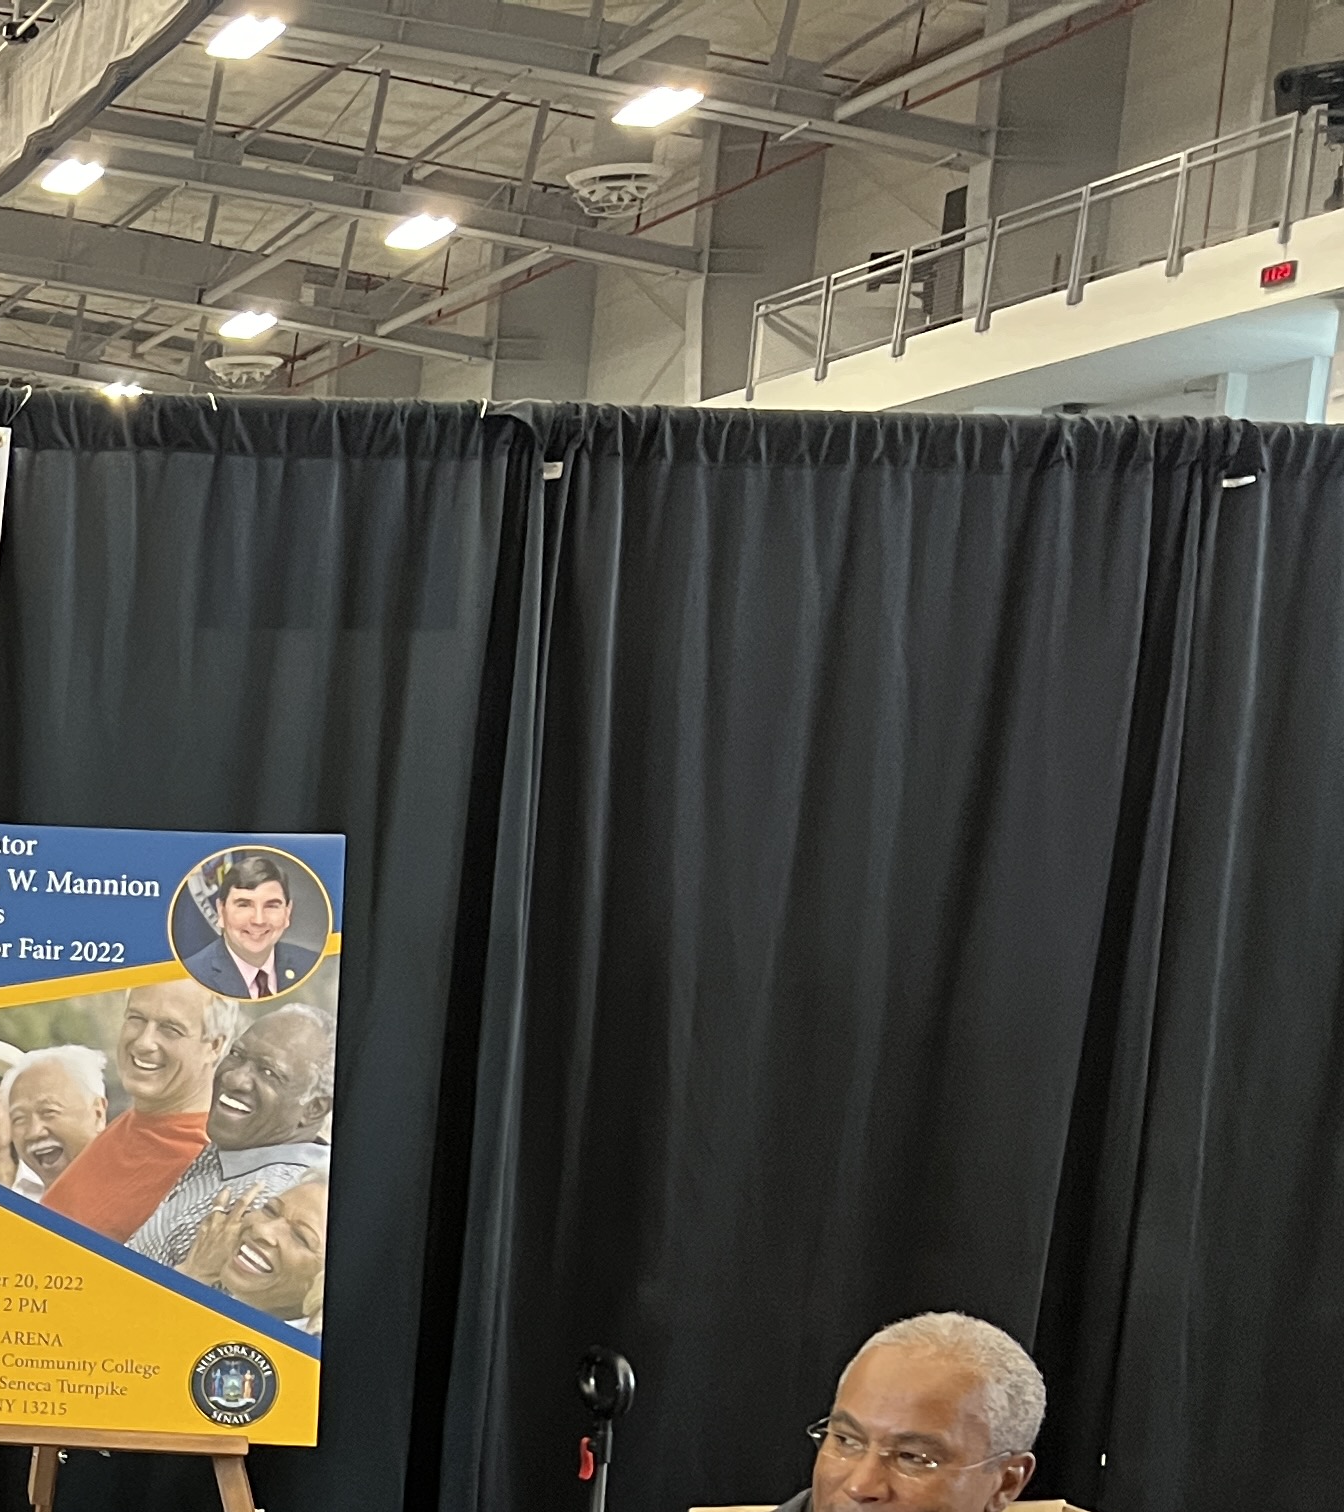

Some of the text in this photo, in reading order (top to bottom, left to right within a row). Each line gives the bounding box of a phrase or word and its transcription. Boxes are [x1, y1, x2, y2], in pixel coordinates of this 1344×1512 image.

[7, 868, 38, 892] W.
[46, 870, 160, 897] Mannion
[19, 937, 64, 961] Fair
[70, 941, 125, 963] 2022
[14, 1274, 38, 1290] 20,
[44, 1275, 84, 1291] 2022
[3, 1298, 12, 1311] 2
[18, 1298, 47, 1313] PM
[0, 1331, 63, 1347] ARENA
[2, 1353, 97, 1375] Community
[102, 1359, 161, 1379] College
[196, 1345, 272, 1376] NEW YORK STATE
[0, 1376, 51, 1392] Seneca
[56, 1379, 128, 1398] Turnpike
[22, 1400, 67, 1415] 13215
[211, 1411, 251, 1423] SENATE
